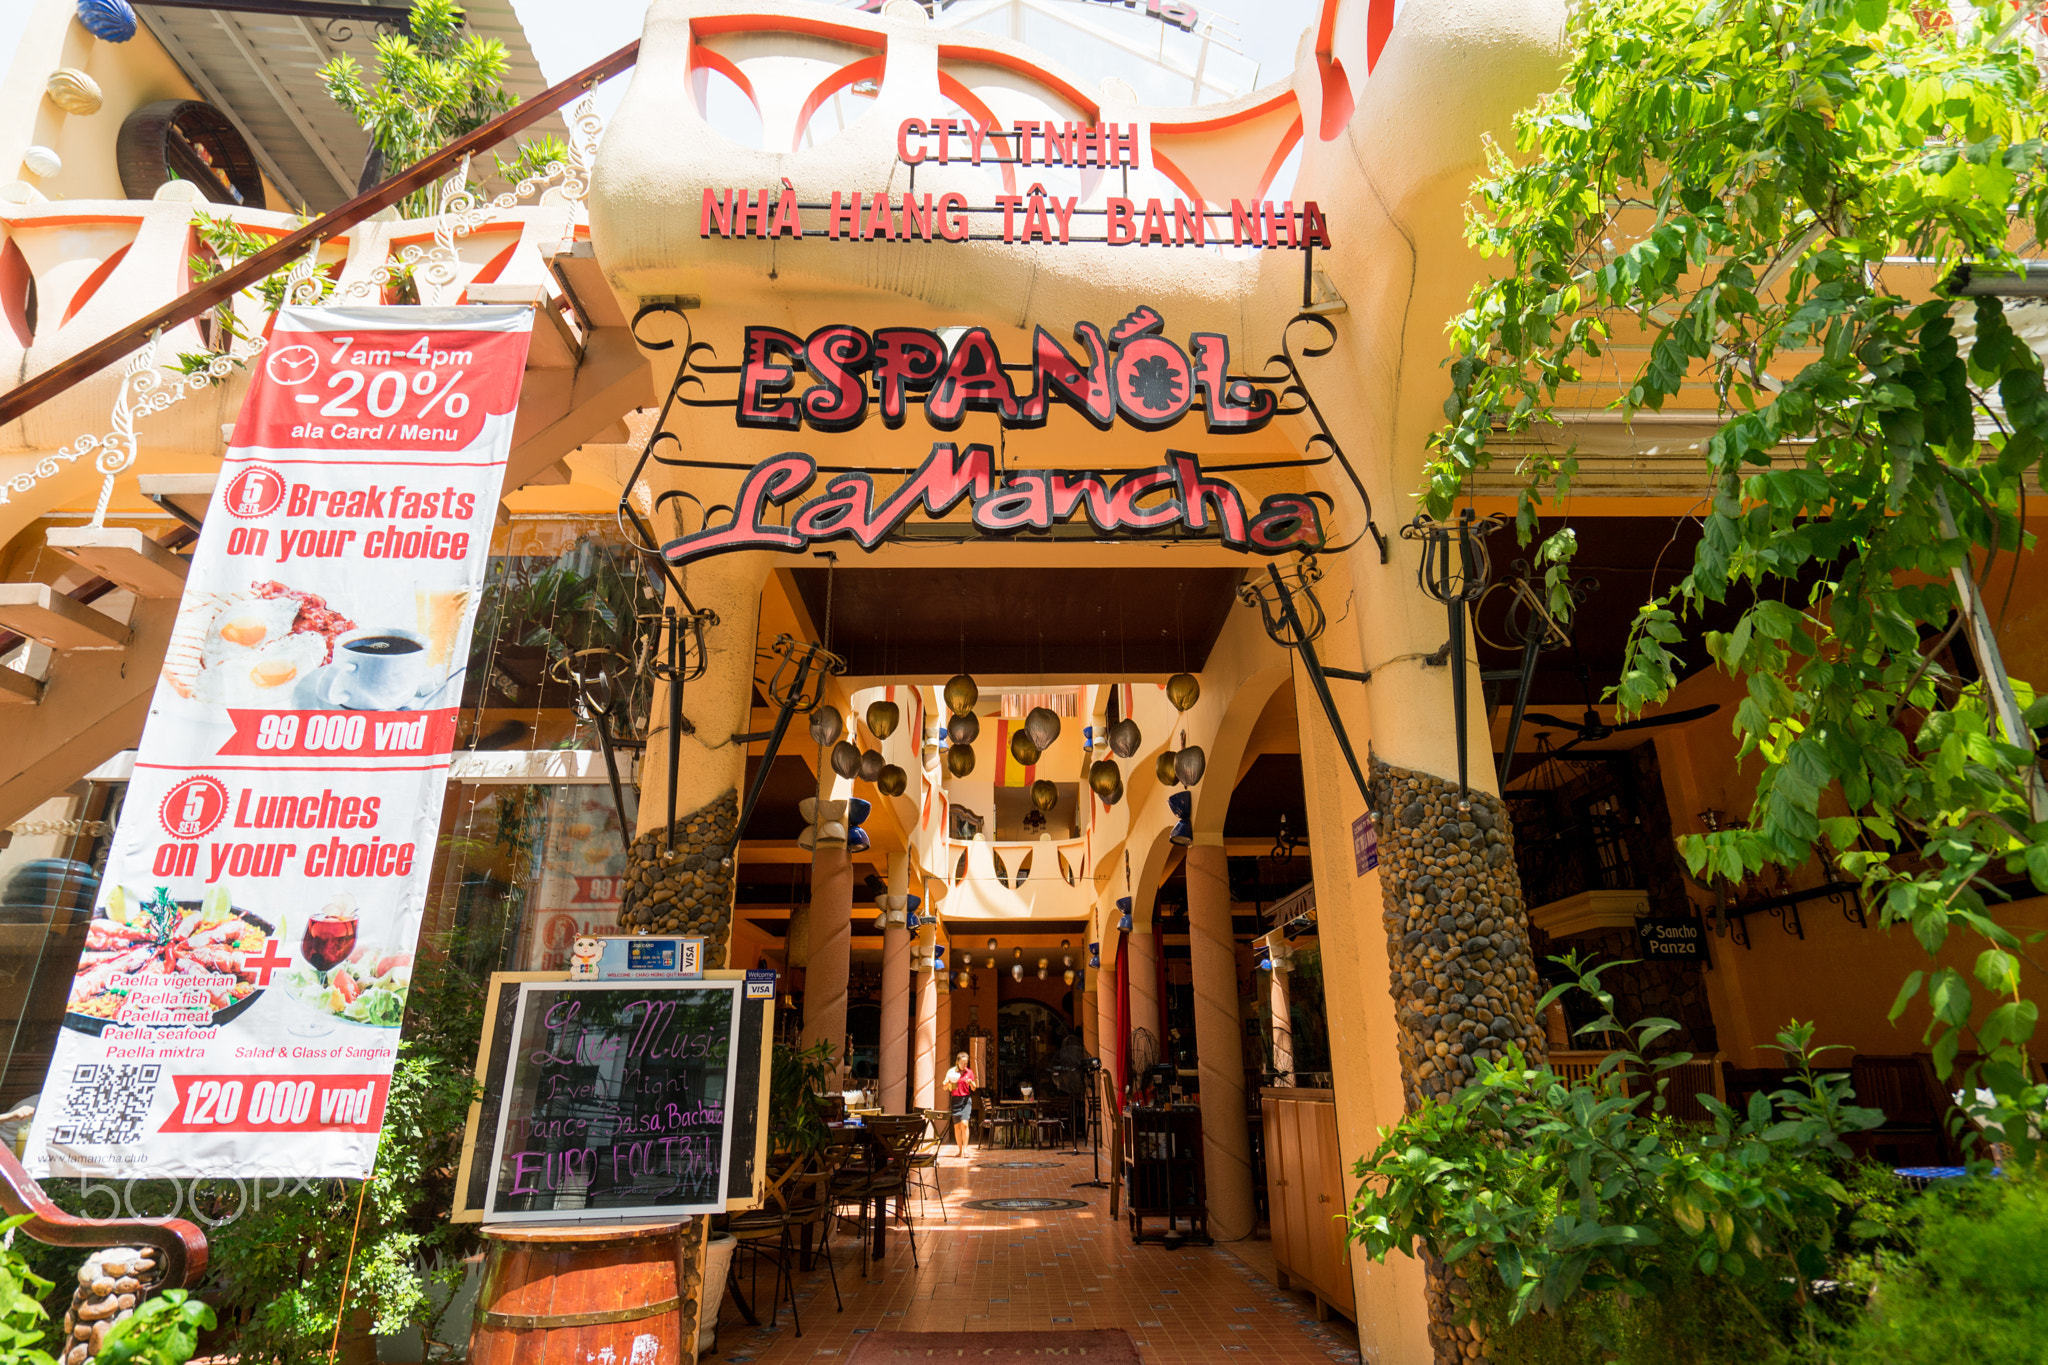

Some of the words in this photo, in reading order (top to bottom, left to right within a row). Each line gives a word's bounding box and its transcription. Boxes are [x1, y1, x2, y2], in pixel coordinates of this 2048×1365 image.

[898, 118, 990, 166] CTY
[1013, 119, 1140, 169] TNHH
[700, 177, 802, 241] NHÀ
[829, 191, 969, 243] HANG
[996, 182, 1079, 245] TÂY
[1107, 197, 1206, 248] BAN
[1231, 199, 1332, 250] NHA
[331, 336, 473, 370] 7am-4pm
[295, 370, 470, 420] -20%
[291, 423, 323, 438] ala
[330, 423, 383, 440] Card
[399, 424, 458, 441] Menu
[242, 473, 267, 506] 5
[286, 483, 476, 520] Breakfasts
[227, 527, 269, 557] on
[276, 528, 357, 564] your
[363, 525, 470, 561] choice
[256, 714, 300, 750] 99
[303, 714, 367, 751] 000
[375, 715, 428, 751] vnd
[182, 784, 208, 822] 5
[233, 788, 381, 829] Lunches
[178, 821, 201, 834] SETS
[152, 842, 200, 877] on
[205, 842, 297, 884] your
[303, 836, 416, 878] choice
[1649, 940, 1696, 954] Panza
[1656, 924, 1697, 939] Sancho
[685, 946, 695, 968] VISA
[110, 974, 161, 987] Paella
[164, 974, 234, 989] vigeterian
[131, 992, 179, 1004] Paella
[182, 992, 208, 1004] fish
[751, 985, 770, 993] VISA
[121, 1010, 169, 1022] Paella
[172, 1010, 210, 1022] meat
[104, 1028, 150, 1040] Paella
[155, 1027, 217, 1040] seafood
[106, 1046, 157, 1058] Paella
[160, 1046, 205, 1058] mixtra
[235, 1046, 275, 1059] Salad
[278, 1046, 288, 1058] &
[291, 1046, 327, 1059] Glass
[330, 1046, 343, 1058] of
[345, 1046, 391, 1061] Sangria
[182, 1081, 243, 1124] 120
[247, 1081, 316, 1124] 000
[320, 1081, 376, 1124] vnd
[508, 1147, 598, 1197] EURO
